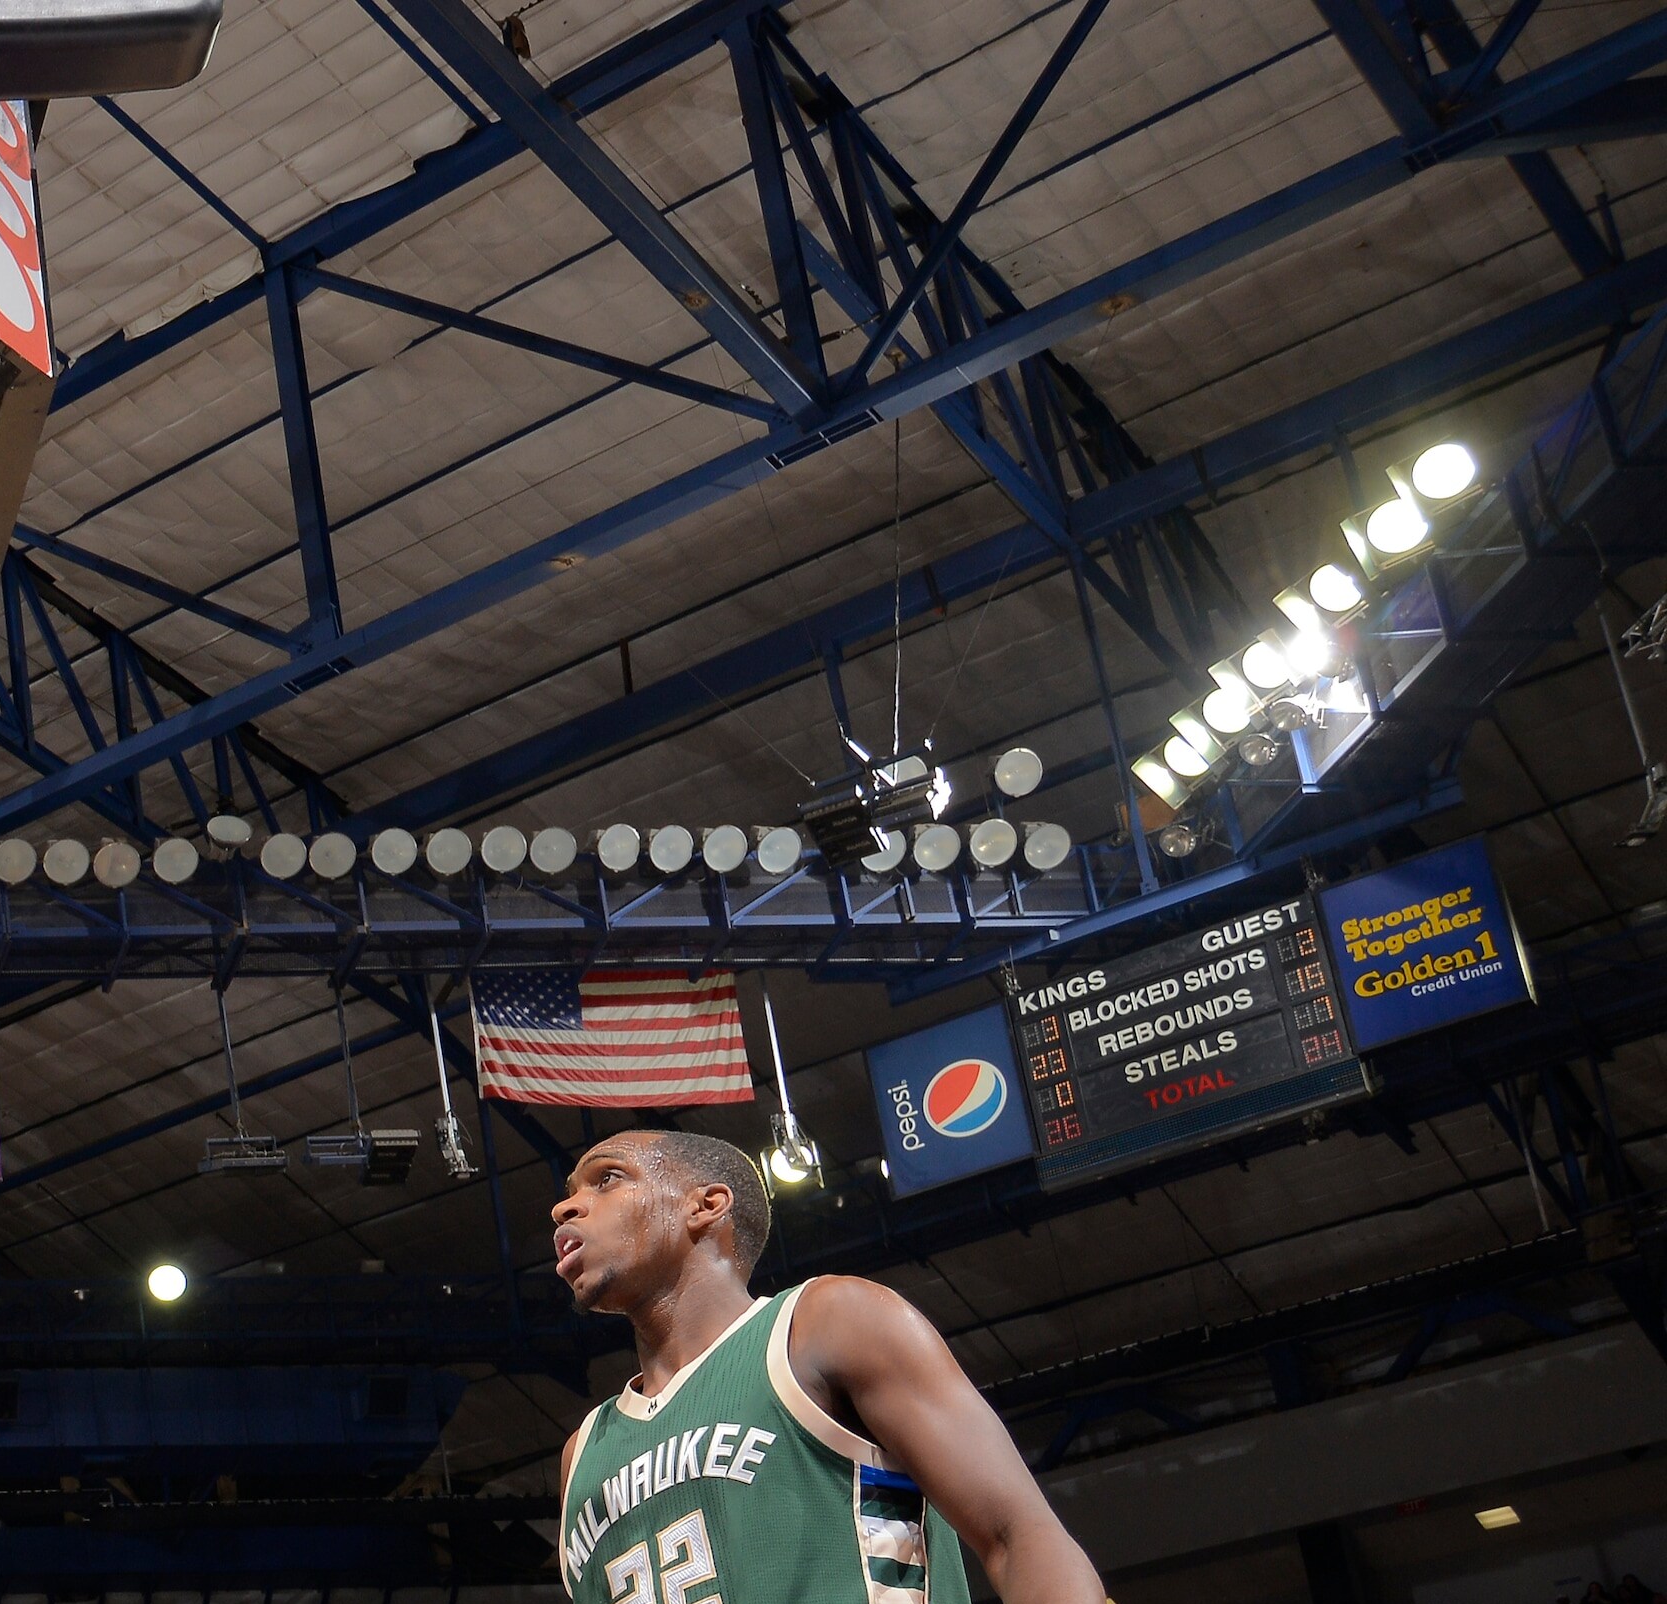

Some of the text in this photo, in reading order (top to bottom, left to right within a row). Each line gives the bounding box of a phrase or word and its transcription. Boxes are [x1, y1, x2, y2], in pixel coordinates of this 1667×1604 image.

[1201, 901, 1301, 952] GUEST
[1341, 886, 1472, 941] Stronger
[1346, 907, 1483, 962] Together
[1295, 928, 1317, 956] 2
[1017, 970, 1107, 1015] KINGS
[1068, 948, 1267, 1032] BLOCKED SHOTS
[1411, 961, 1503, 997] Credit Union
[1040, 1014, 1060, 1042] 3
[1097, 988, 1254, 1056] REBOUNDS
[1313, 996, 1334, 1020] 7
[1029, 1047, 1067, 1080] 23
[1124, 1030, 1238, 1083] STEALS
[1054, 1080, 1074, 1108] 0
[1142, 1069, 1237, 1110] TOTAL
[887, 1081, 926, 1151] pepsi
[1044, 1112, 1083, 1145] 26
[566, 1422, 777, 1583] MILWAUKEE
